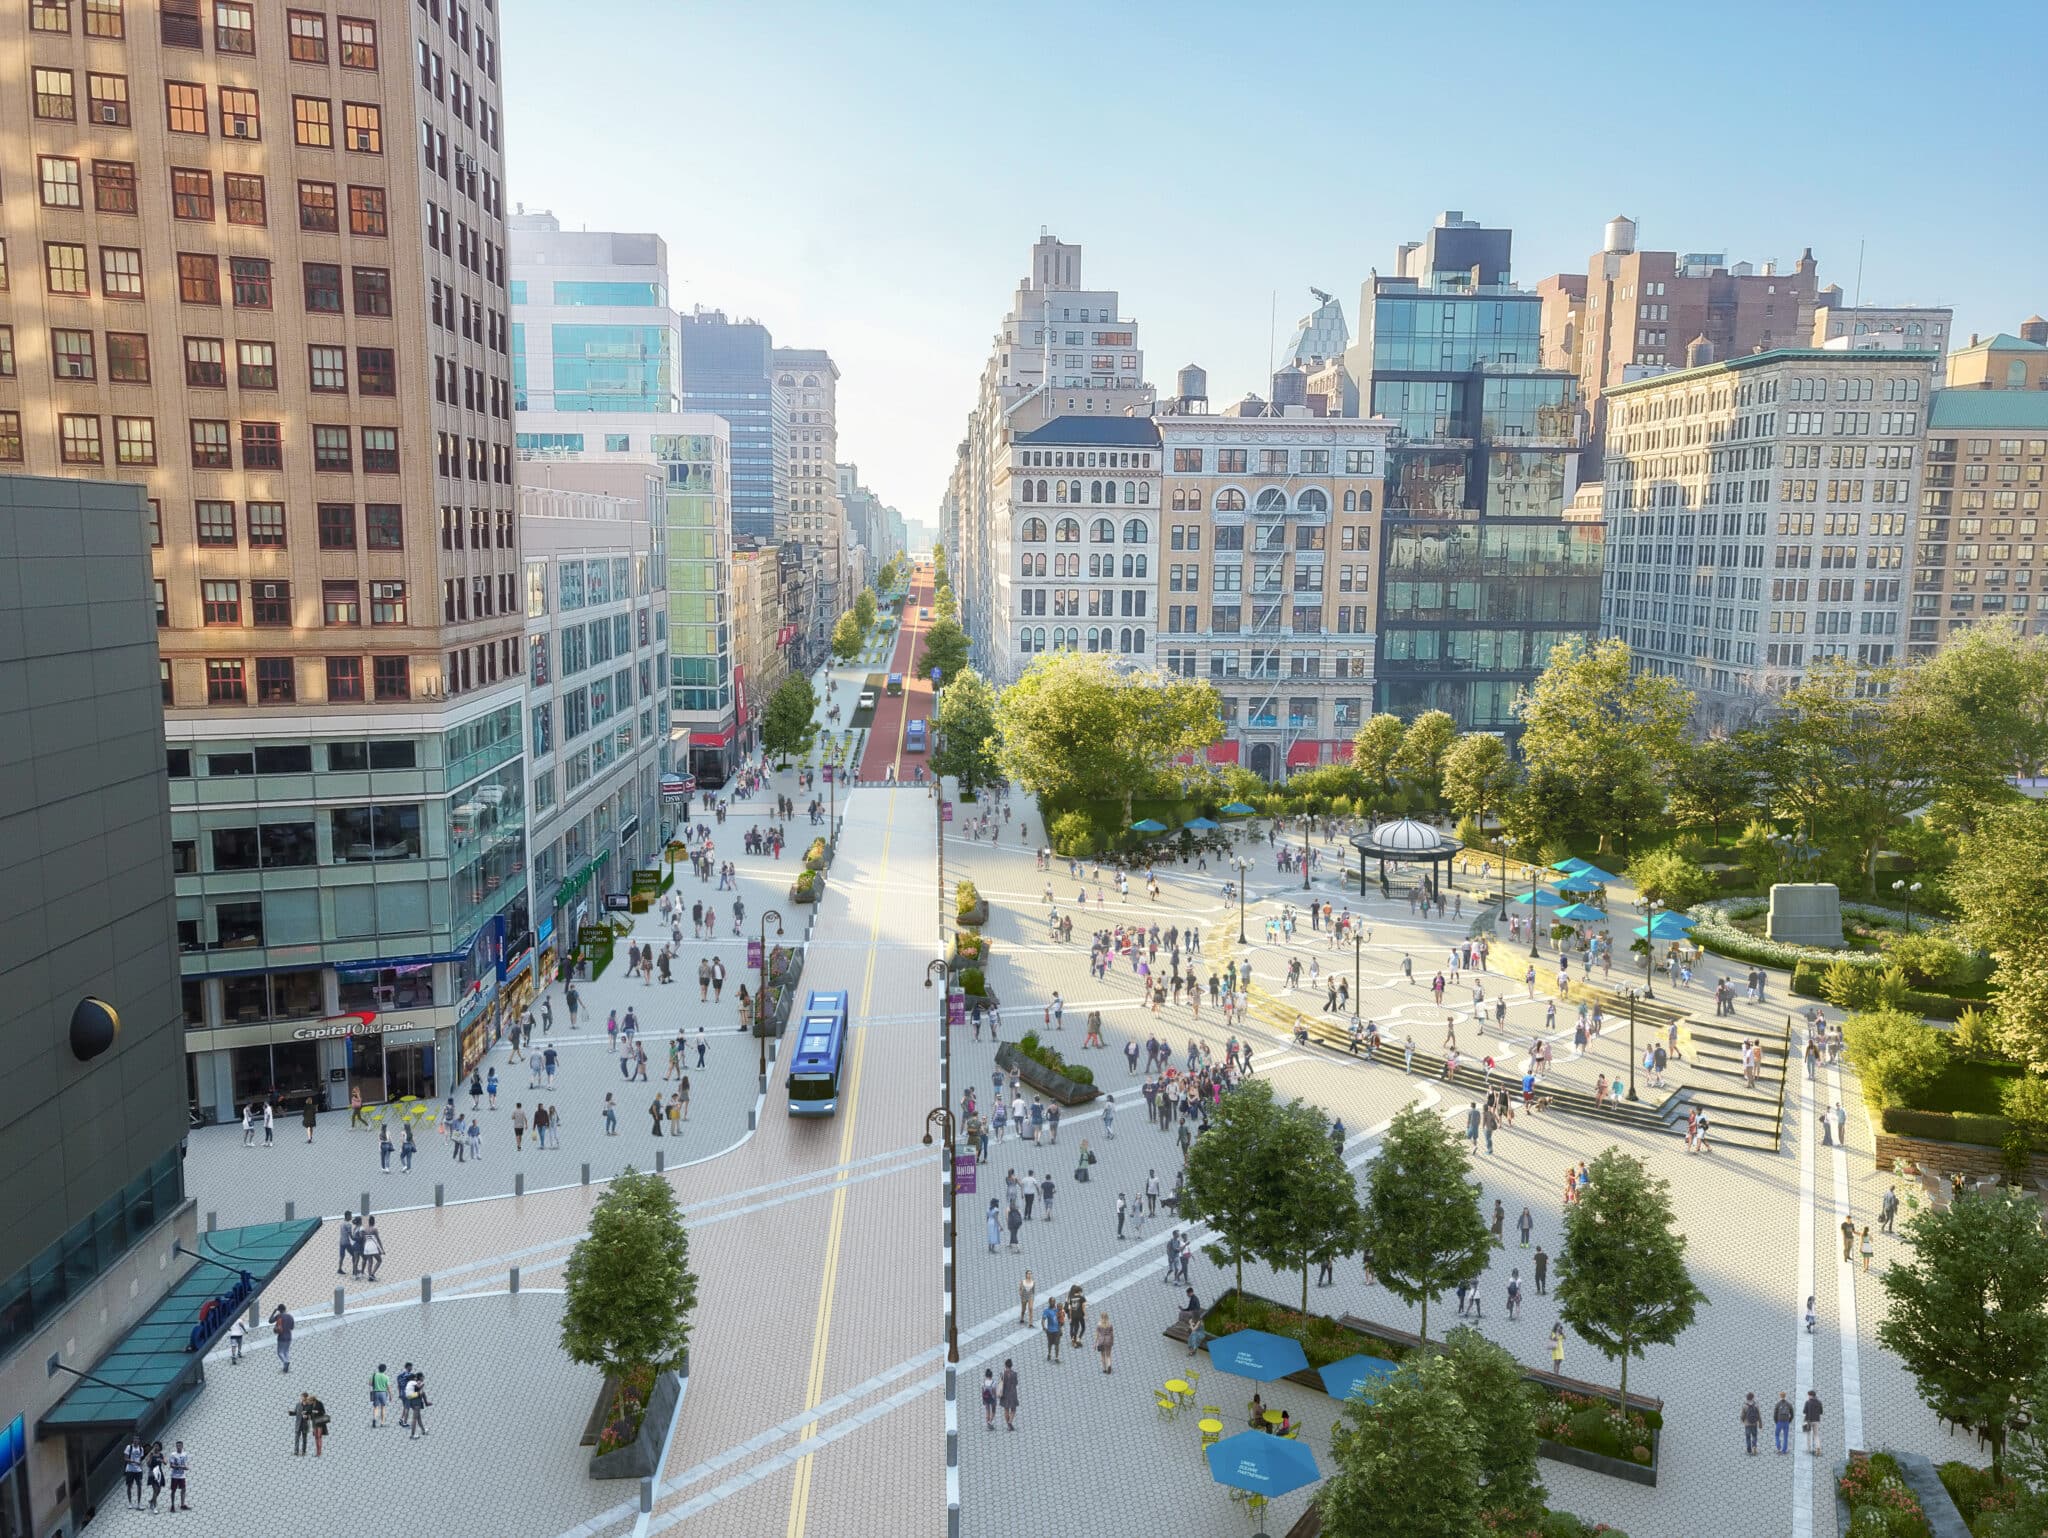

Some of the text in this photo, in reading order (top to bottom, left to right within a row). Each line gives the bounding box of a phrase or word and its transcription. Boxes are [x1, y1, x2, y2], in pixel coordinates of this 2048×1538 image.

[664, 795, 682, 803] DSW
[382, 1020, 416, 1033] Bank
[956, 1164, 975, 1177] UNION
